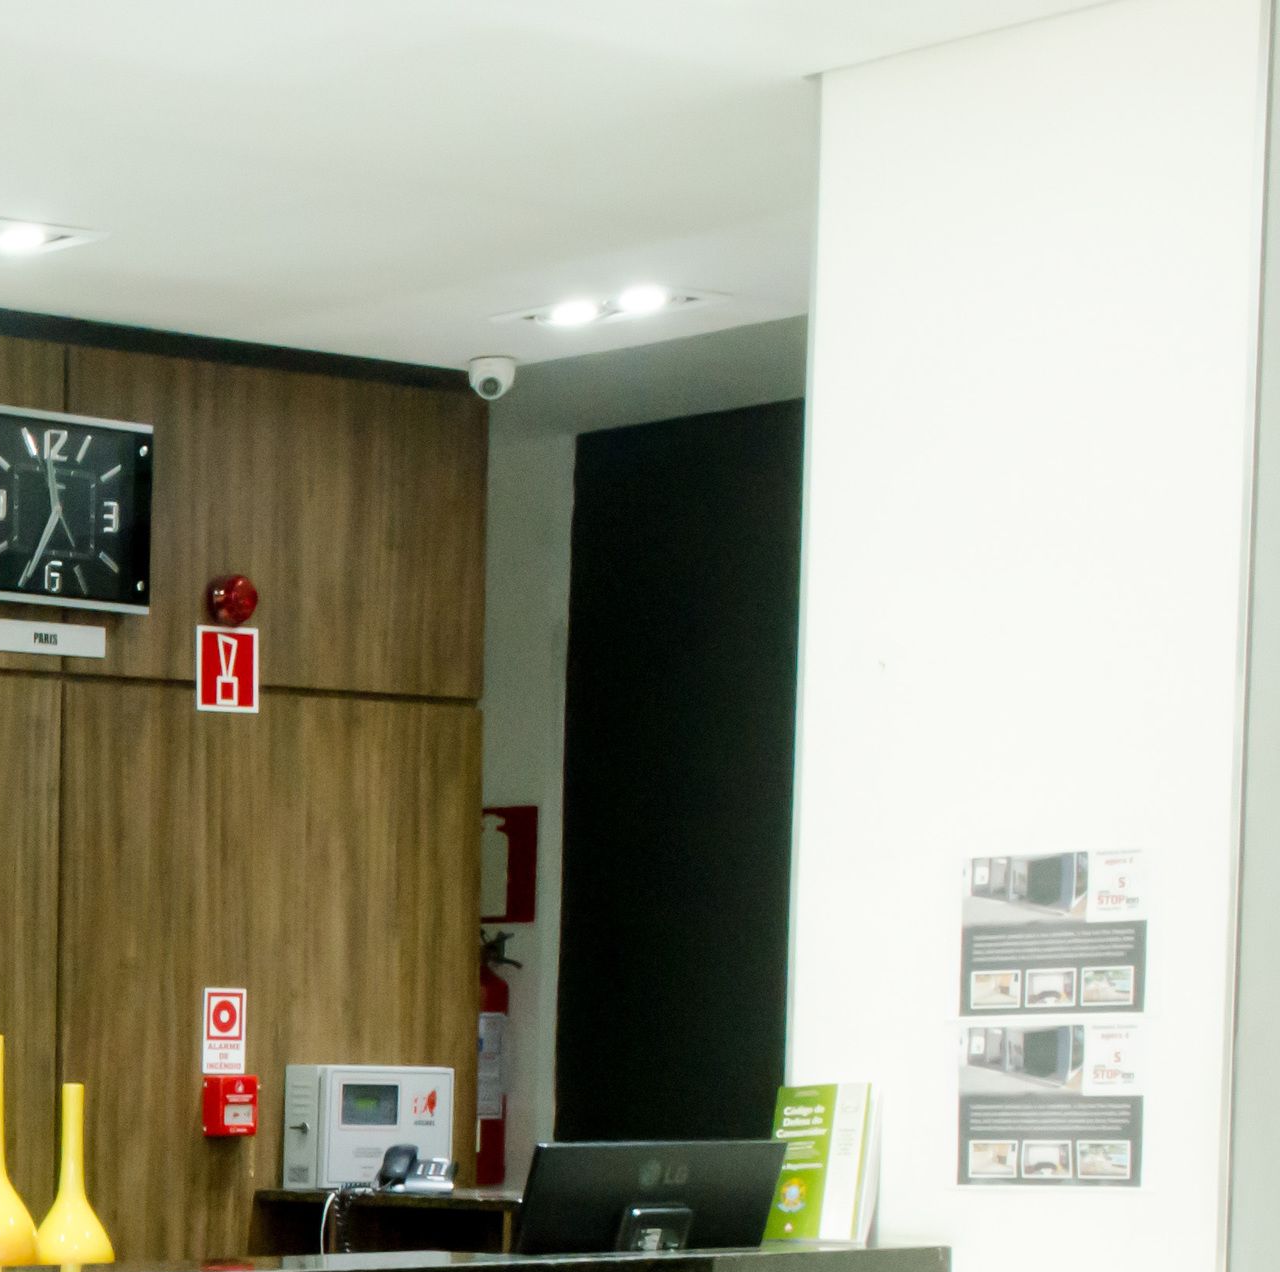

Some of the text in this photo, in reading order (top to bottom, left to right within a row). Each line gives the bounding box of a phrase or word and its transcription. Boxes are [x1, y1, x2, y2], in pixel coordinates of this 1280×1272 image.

[44, 429, 69, 462] 12
[103, 501, 120, 532] 3
[44, 560, 63, 592] 6
[33, 632, 58, 646] PARIS
